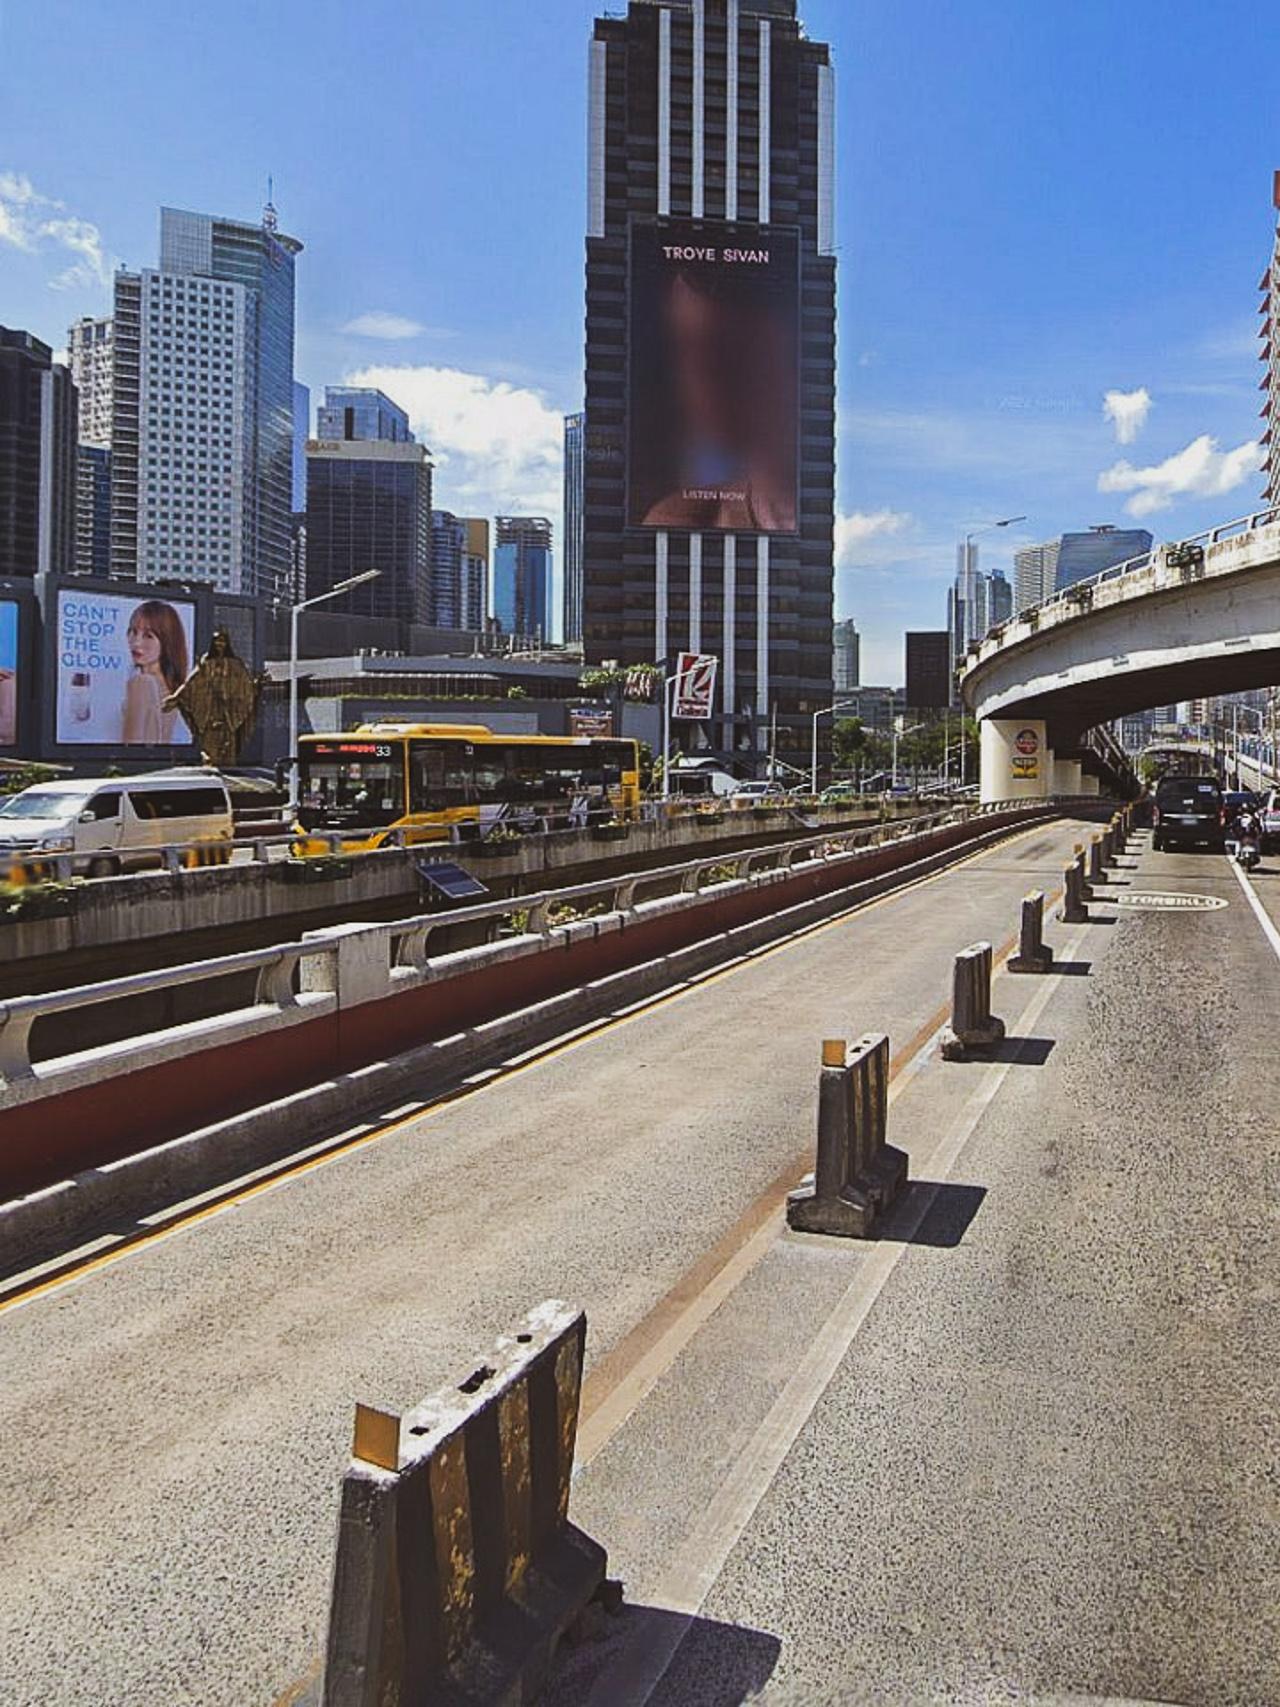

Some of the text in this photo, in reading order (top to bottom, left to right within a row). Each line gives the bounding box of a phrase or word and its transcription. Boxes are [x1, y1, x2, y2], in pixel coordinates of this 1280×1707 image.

[662, 246, 770, 263] TROYE SIVAN
[63, 603, 120, 620] CAN'T
[63, 620, 116, 637] STOP
[64, 637, 101, 652] THE
[61, 652, 121, 669] GLOW
[376, 745, 392, 757] 33
